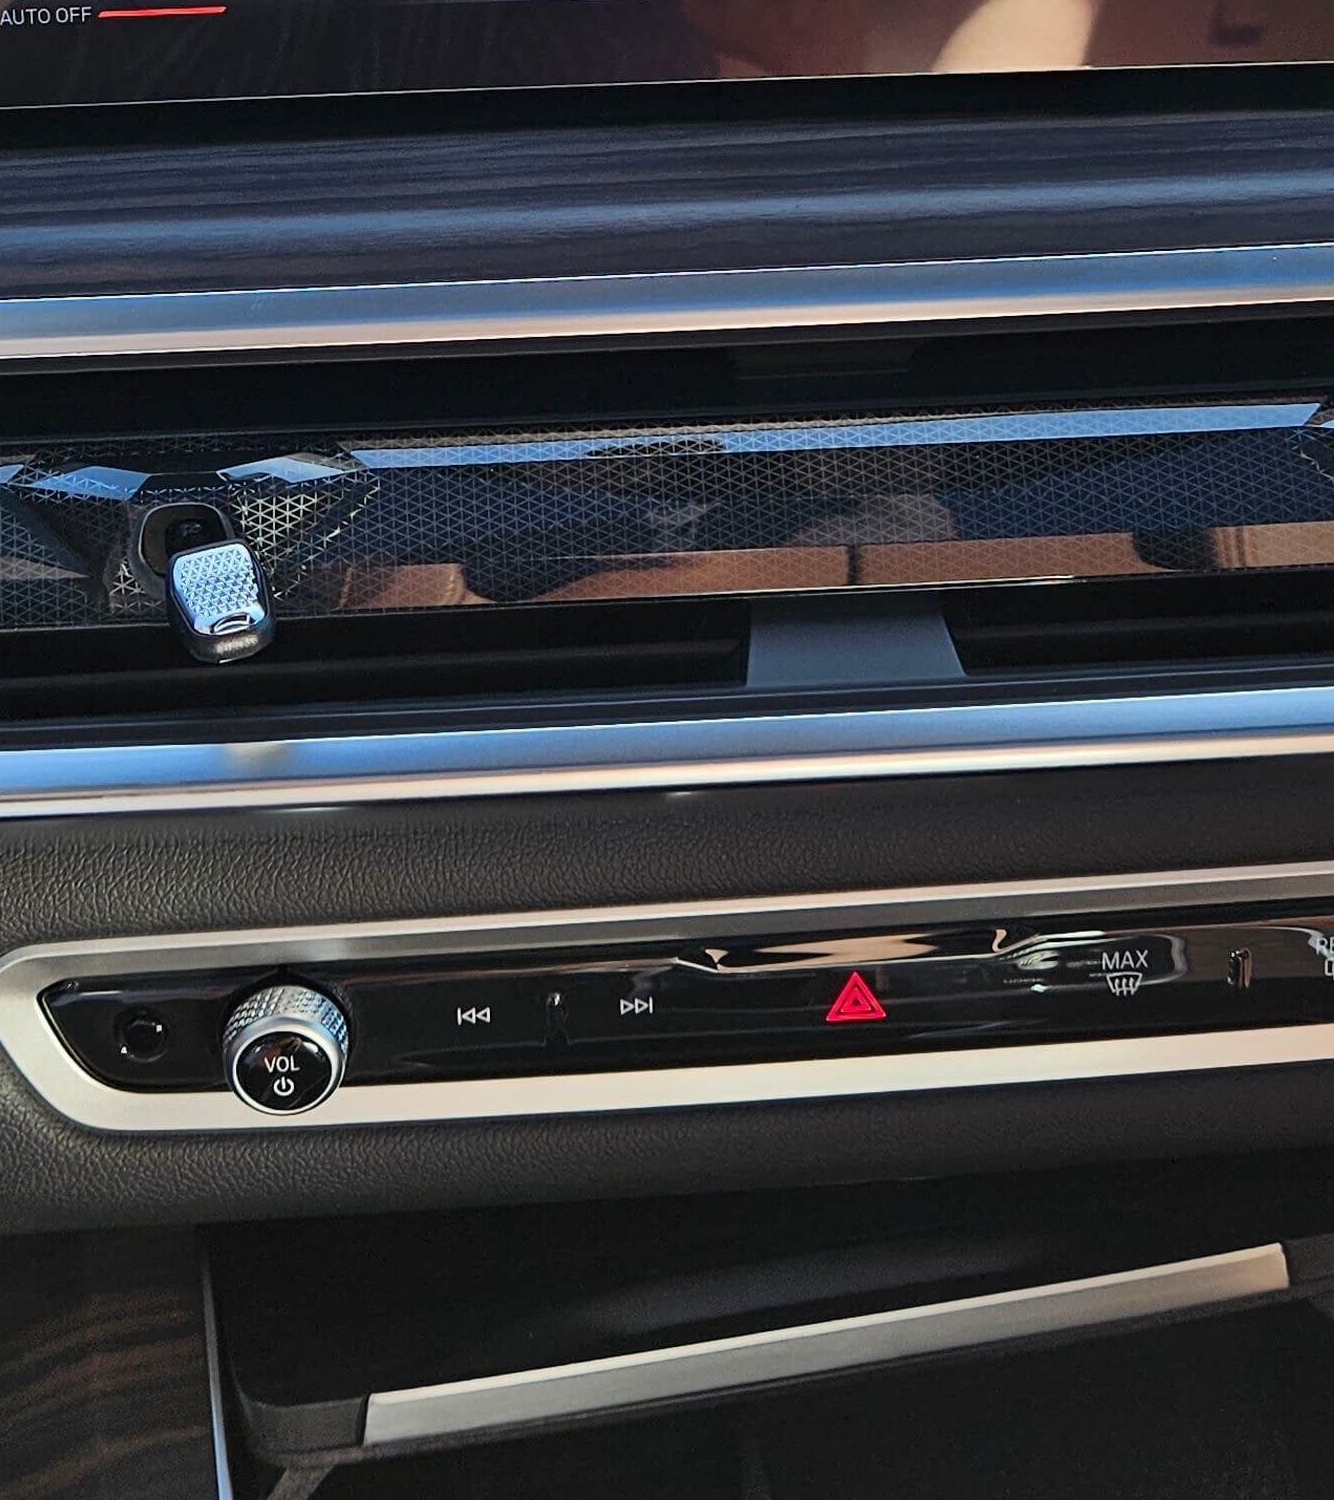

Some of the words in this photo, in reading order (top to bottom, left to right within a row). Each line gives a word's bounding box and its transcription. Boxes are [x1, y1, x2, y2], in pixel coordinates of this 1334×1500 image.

[0, 7, 51, 26] AUTO
[55, 6, 91, 24] OFF
[1101, 949, 1149, 970] MAX
[264, 1055, 300, 1074] VOL
